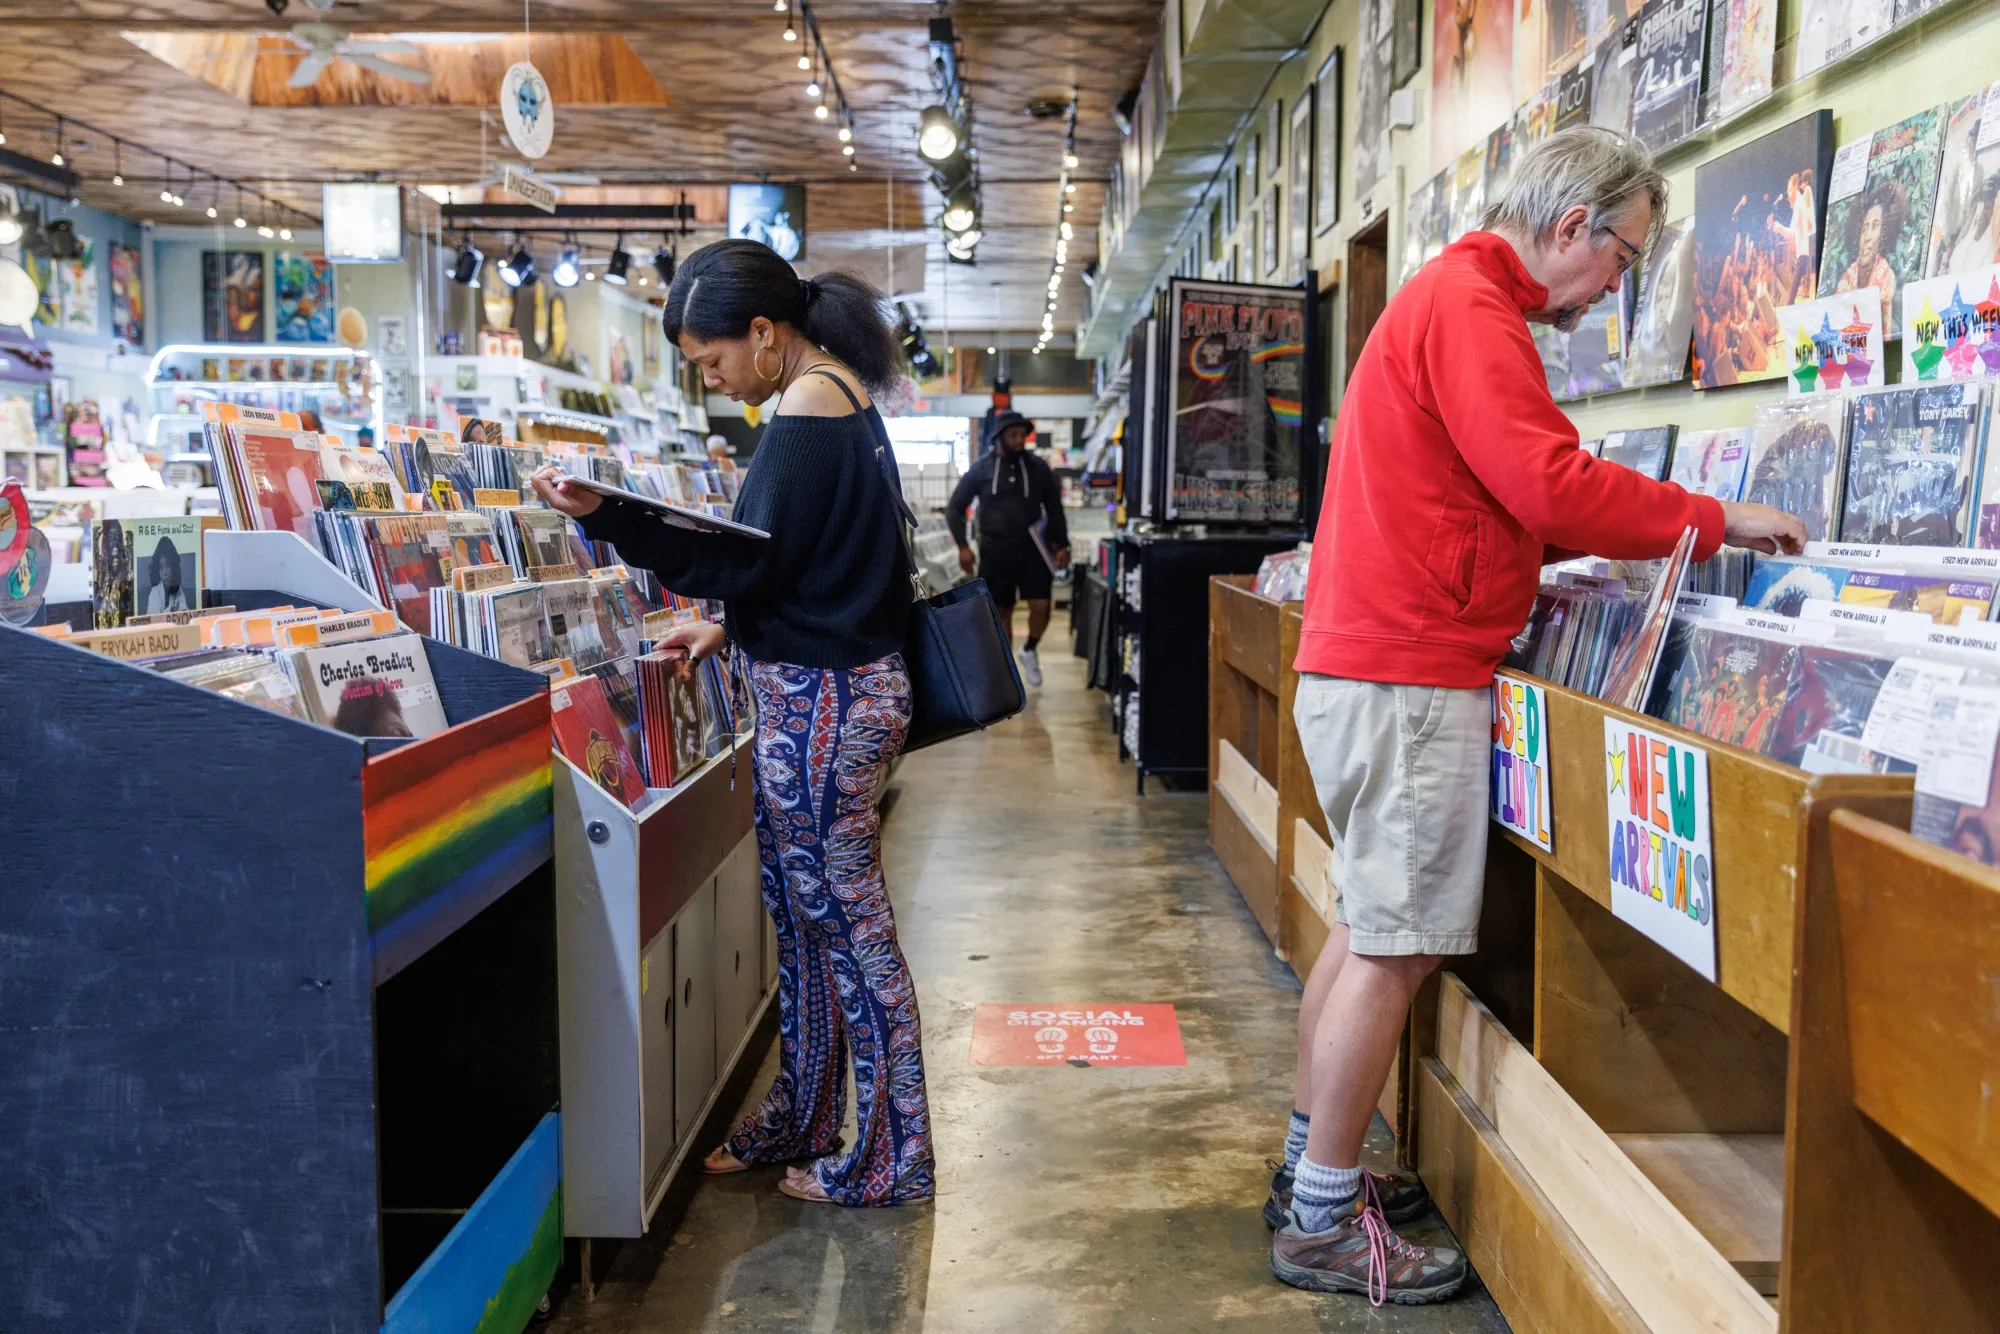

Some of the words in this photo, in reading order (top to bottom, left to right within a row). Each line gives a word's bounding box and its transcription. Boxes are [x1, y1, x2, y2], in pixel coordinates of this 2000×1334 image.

[1181, 303, 1236, 339] PINK
[1236, 306, 1304, 345] FLOYD
[1916, 319, 1940, 344] NEW
[1943, 313, 1968, 340] THIS
[1795, 344, 1813, 362] NEW
[1816, 340, 1833, 360] THIS
[242, 410, 255, 418] LEON
[255, 412, 276, 421] BRIDGES
[1919, 410, 1940, 421] TONY
[1941, 406, 1970, 420] CAREY
[138, 526, 144, 536] R
[157, 525, 171, 535] Funk
[172, 525, 182, 534] and
[182, 523, 194, 534] Soul
[1828, 548, 1839, 556] USED
[1839, 549, 1849, 557] NEW
[1849, 549, 1872, 558] ARRIVALS
[1875, 549, 1881, 558] D
[1942, 556, 1956, 565] USED
[1956, 556, 1970, 566] NEW
[1970, 558, 1998, 567] ARRIVALS
[1948, 583, 1975, 597] GREATEST
[1830, 609, 1842, 618] USED
[1842, 611, 1854, 620] NEW
[1854, 613, 1878, 624] ARRIVALS
[319, 623, 346, 635] CHARLES
[346, 618, 371, 630] BRADLEY
[1745, 618, 1757, 626] USED
[1757, 620, 1767, 629] NEW
[1767, 622, 1789, 633] ARRIVALS
[101, 636, 146, 657] ERYKAH
[149, 634, 179, 652] BADU
[1928, 633, 1944, 644] USED
[1945, 635, 1961, 647] NEW
[1962, 638, 1997, 651] ARRIVALS
[320, 661, 366, 687] Charles
[366, 651, 415, 674] Bradley
[386, 677, 404, 691] love
[1491, 678, 1540, 763] USED
[1627, 732, 1695, 842] NEW
[1492, 748, 1549, 845] VINYL
[1611, 819, 1711, 926] ARRIVALS
[1007, 1010, 1144, 1020] SOCIAL
